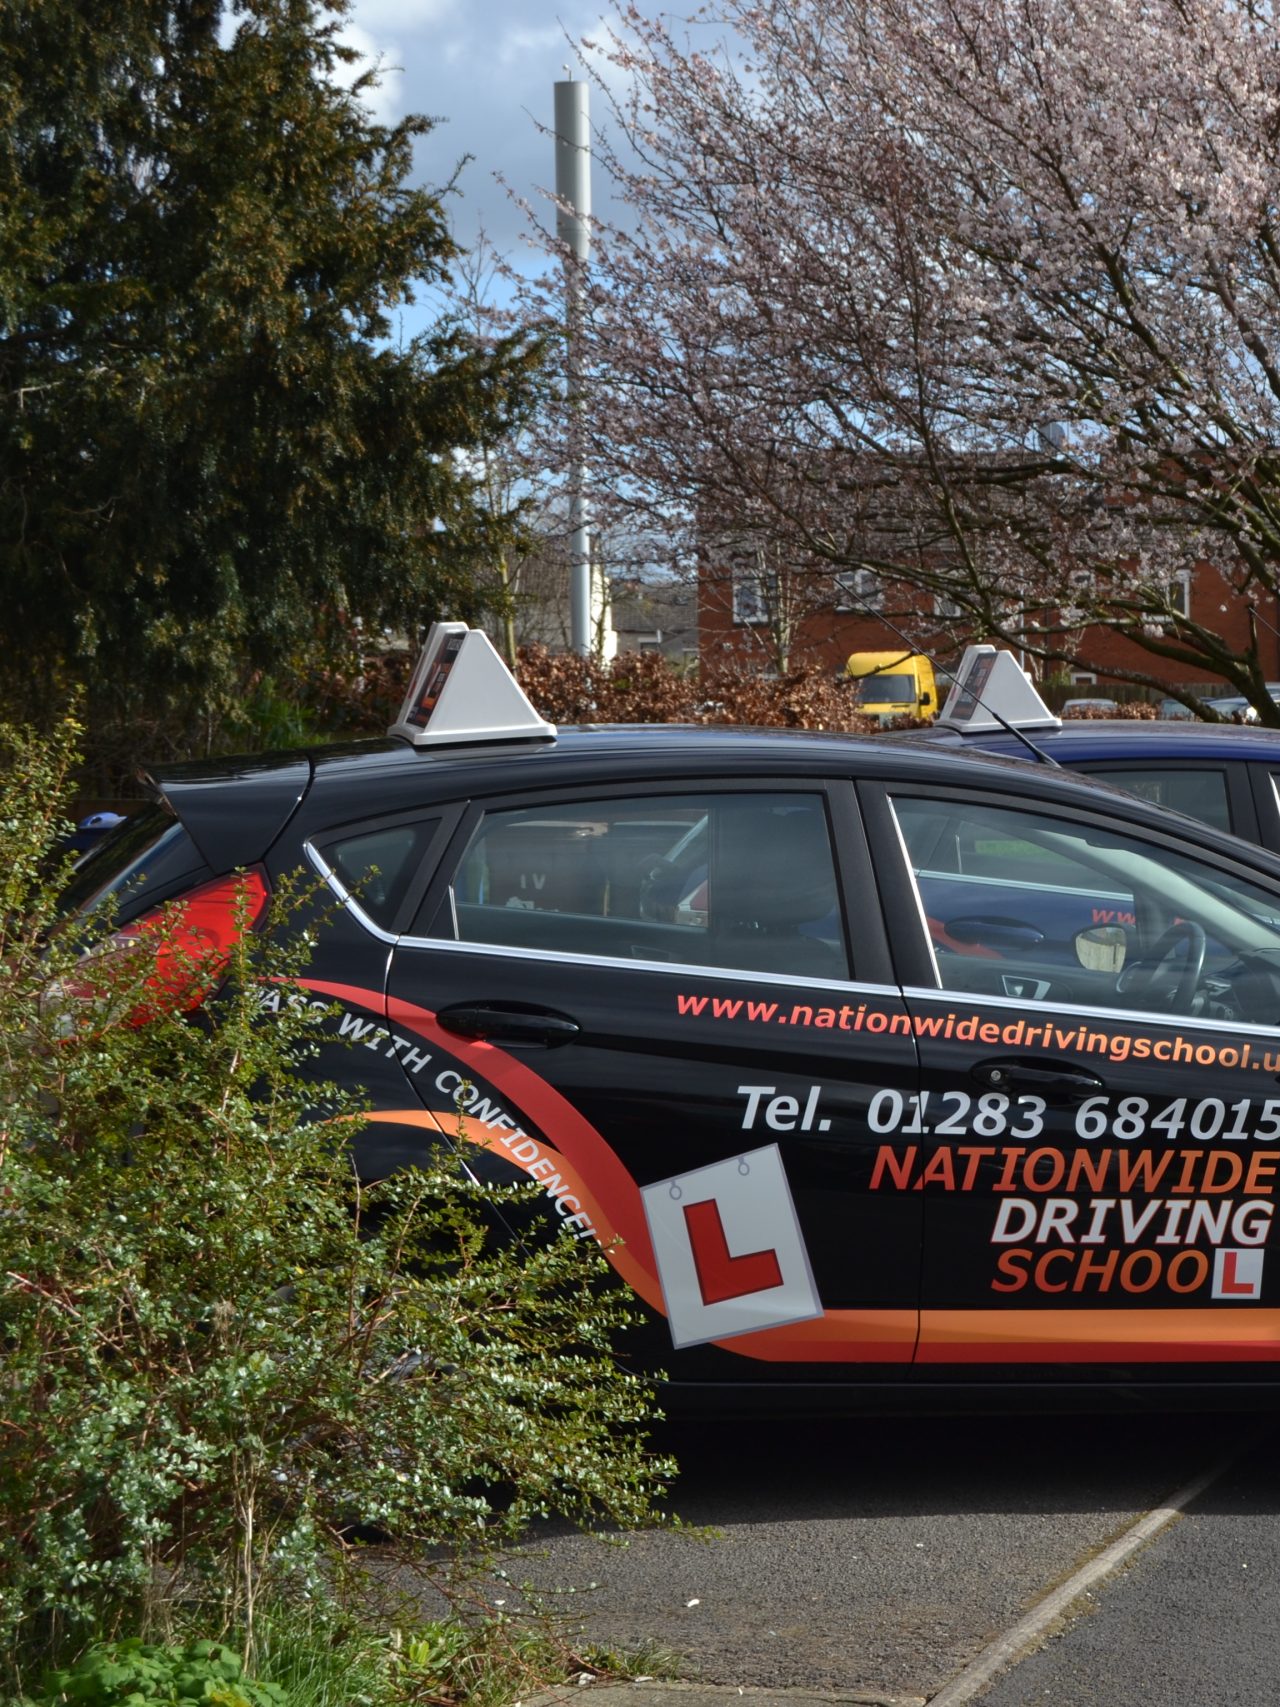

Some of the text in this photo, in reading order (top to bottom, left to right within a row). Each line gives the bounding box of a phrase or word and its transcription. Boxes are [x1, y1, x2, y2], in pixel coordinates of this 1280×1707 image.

[338, 1012, 433, 1074] WITH
[435, 1070, 597, 1240] CONFIDENCE!
[736, 1086, 831, 1131] Tel.
[867, 1088, 1045, 1140] 01283
[869, 1145, 1280, 1194] NATIONWIDE
[991, 1199, 1274, 1246] DRIVING
[683, 1197, 785, 1307] L
